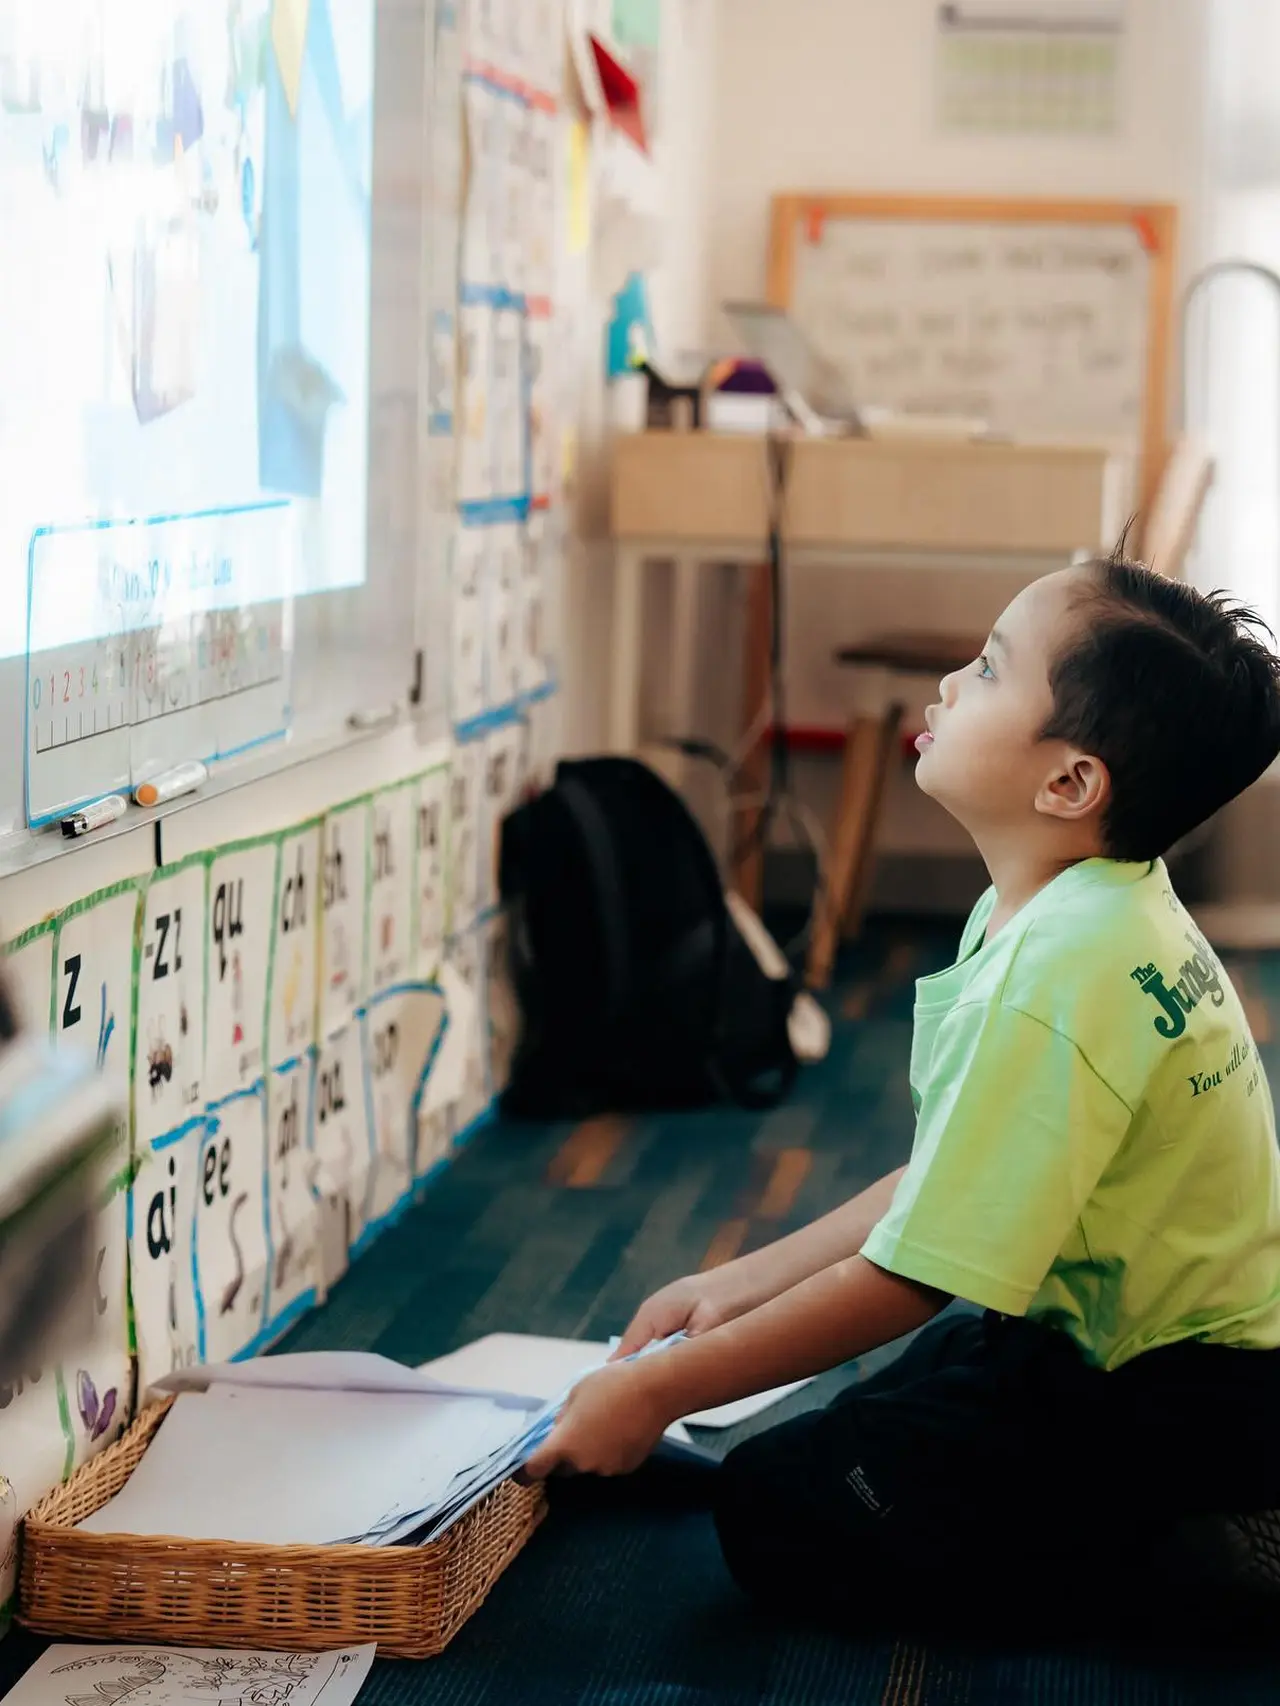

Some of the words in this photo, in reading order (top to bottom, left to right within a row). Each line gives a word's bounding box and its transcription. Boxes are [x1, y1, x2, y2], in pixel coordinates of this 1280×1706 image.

[33, 677, 41, 710] 0
[50, 673, 55, 707] 1
[63, 669, 71, 702] 2
[78, 665, 86, 698] 3
[92, 662, 99, 695] 4
[213, 878, 243, 982] qu
[1130, 962, 1157, 985] The
[1188, 1071, 1223, 1098] You
[1225, 1043, 1242, 1077] will
[203, 1136, 231, 1207] ee
[147, 1155, 175, 1260] ai
